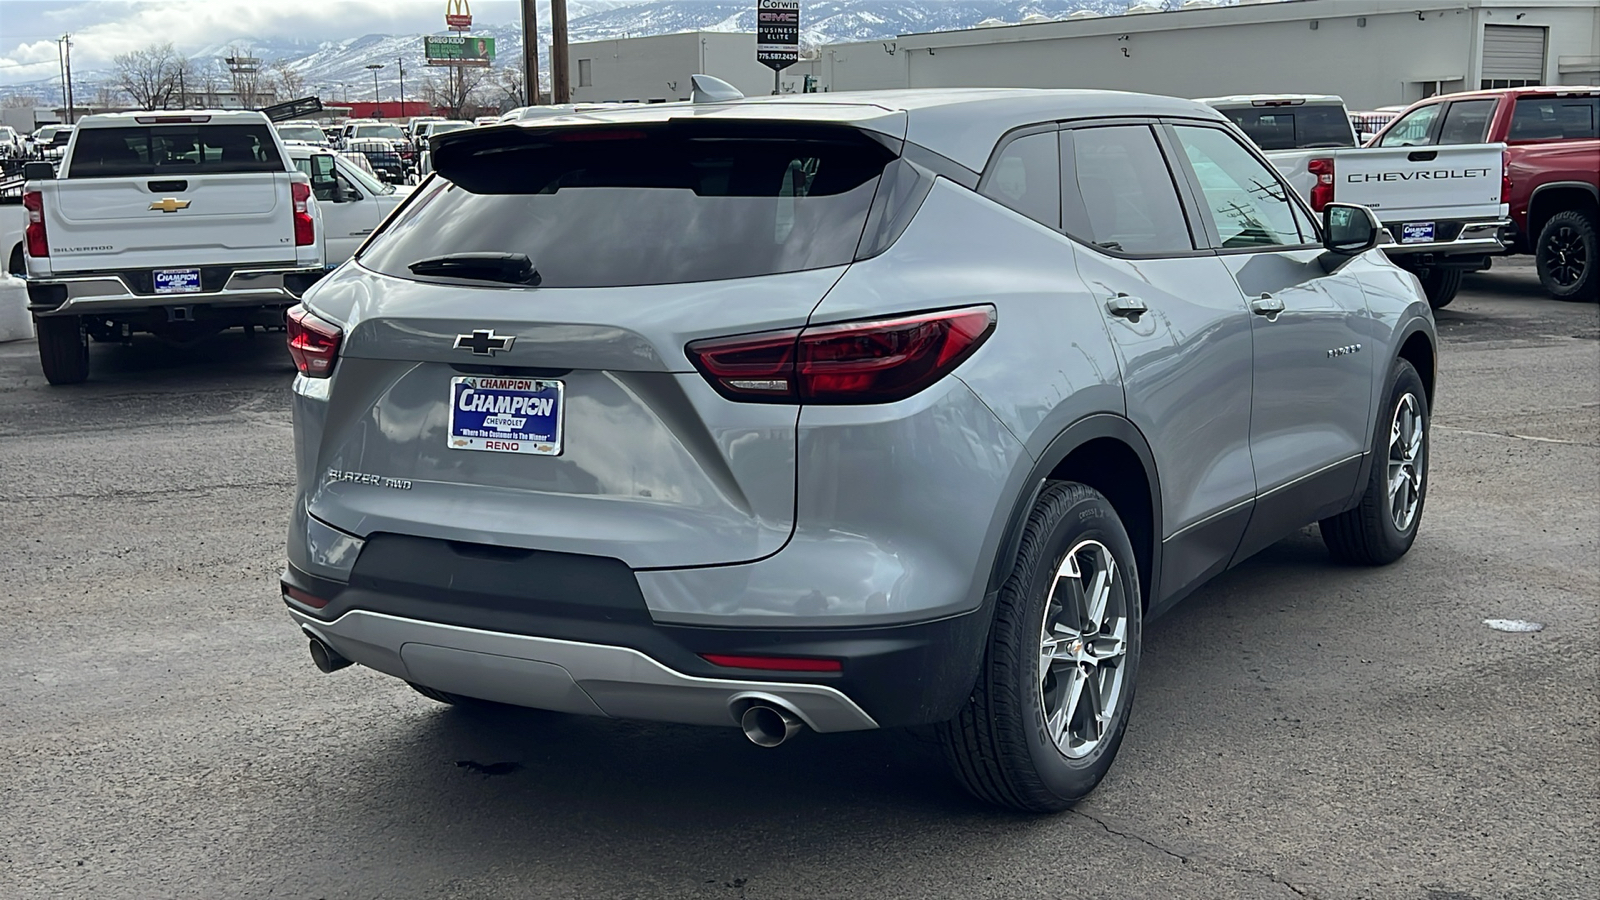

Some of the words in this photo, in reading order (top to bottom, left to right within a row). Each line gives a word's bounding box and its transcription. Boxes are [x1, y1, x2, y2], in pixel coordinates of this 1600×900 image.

[763, 0, 798, 8] Corwin
[760, 13, 797, 21] GMC
[1347, 168, 1492, 183] CHEVROLET
[53, 245, 114, 253] SILVERADO
[156, 273, 198, 282] CHAMPION
[480, 379, 532, 390] CHAMPION
[459, 388, 554, 417] CHAMPION
[486, 417, 523, 427] CHEVROLET
[479, 429, 489, 438] The
[489, 430, 513, 439] Customer
[513, 432, 518, 440] Is
[519, 432, 528, 440] The
[485, 440, 520, 452] RENO
[328, 469, 380, 486] BLAZER
[385, 478, 413, 490] AWD
